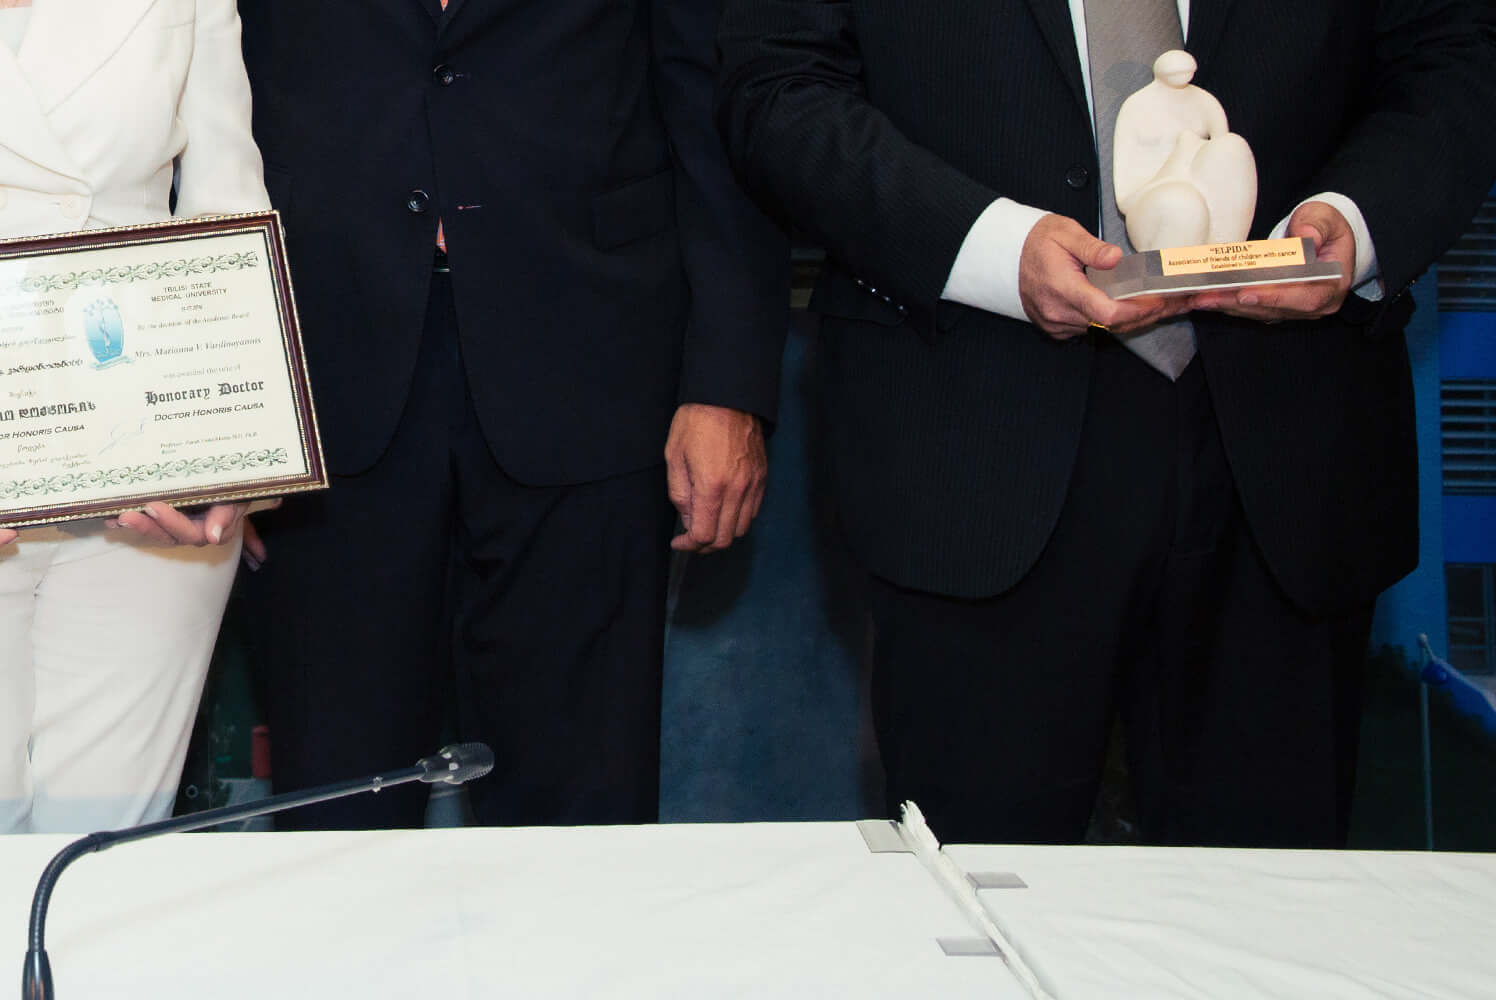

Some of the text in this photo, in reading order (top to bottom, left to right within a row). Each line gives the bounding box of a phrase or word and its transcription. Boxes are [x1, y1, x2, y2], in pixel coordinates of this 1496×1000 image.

[190, 282, 212, 291] STATE
[150, 287, 228, 303] MEDICAL UNIVERSITY
[145, 380, 264, 407] Honorary Doctor
